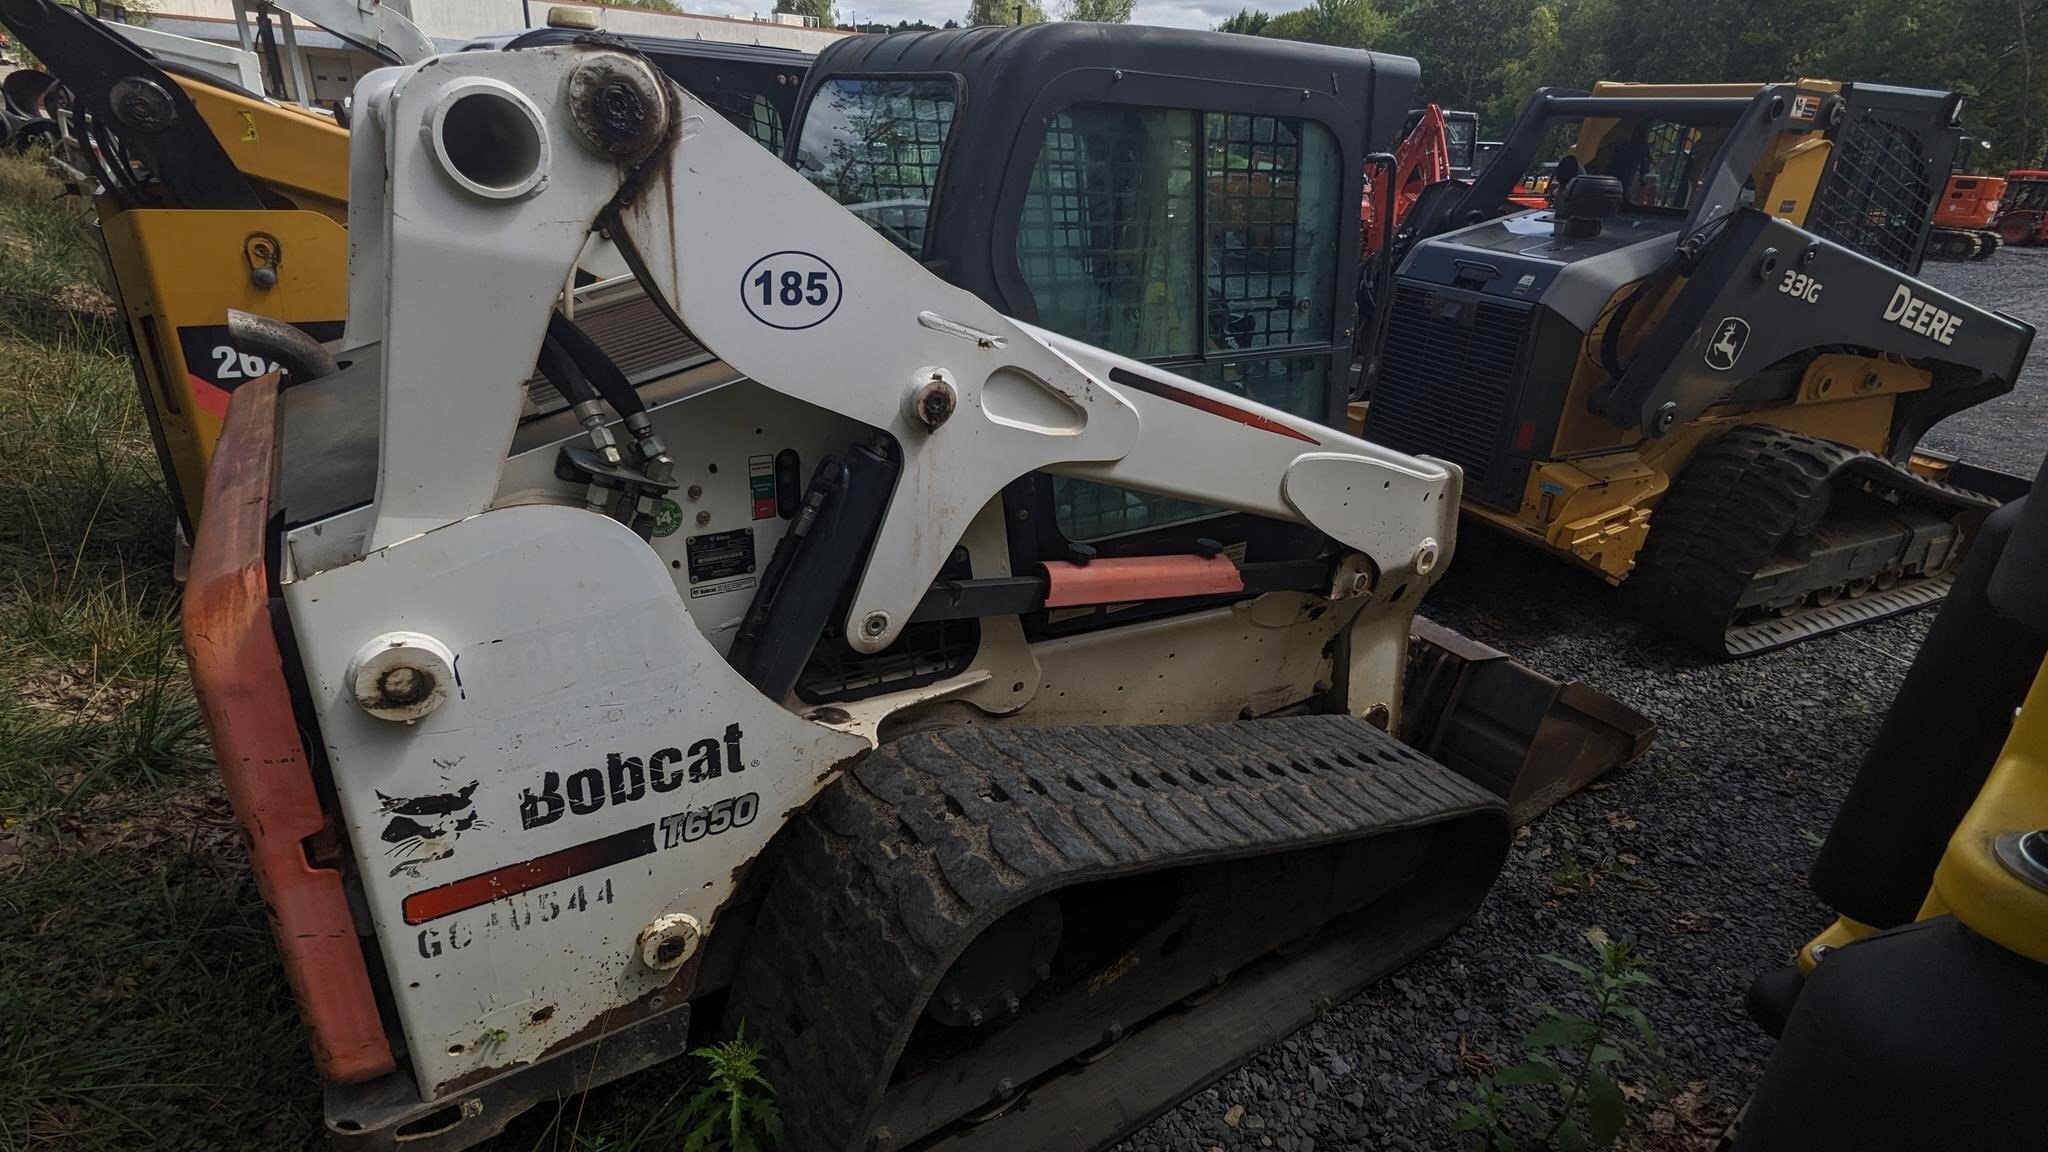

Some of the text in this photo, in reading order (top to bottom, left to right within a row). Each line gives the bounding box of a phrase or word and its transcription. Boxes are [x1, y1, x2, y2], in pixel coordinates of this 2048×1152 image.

[754, 270, 829, 306] 185
[1778, 269, 1824, 304] 331G
[1882, 284, 1963, 346] DEERE
[519, 721, 746, 831] Bobcat
[660, 791, 760, 850] T650
